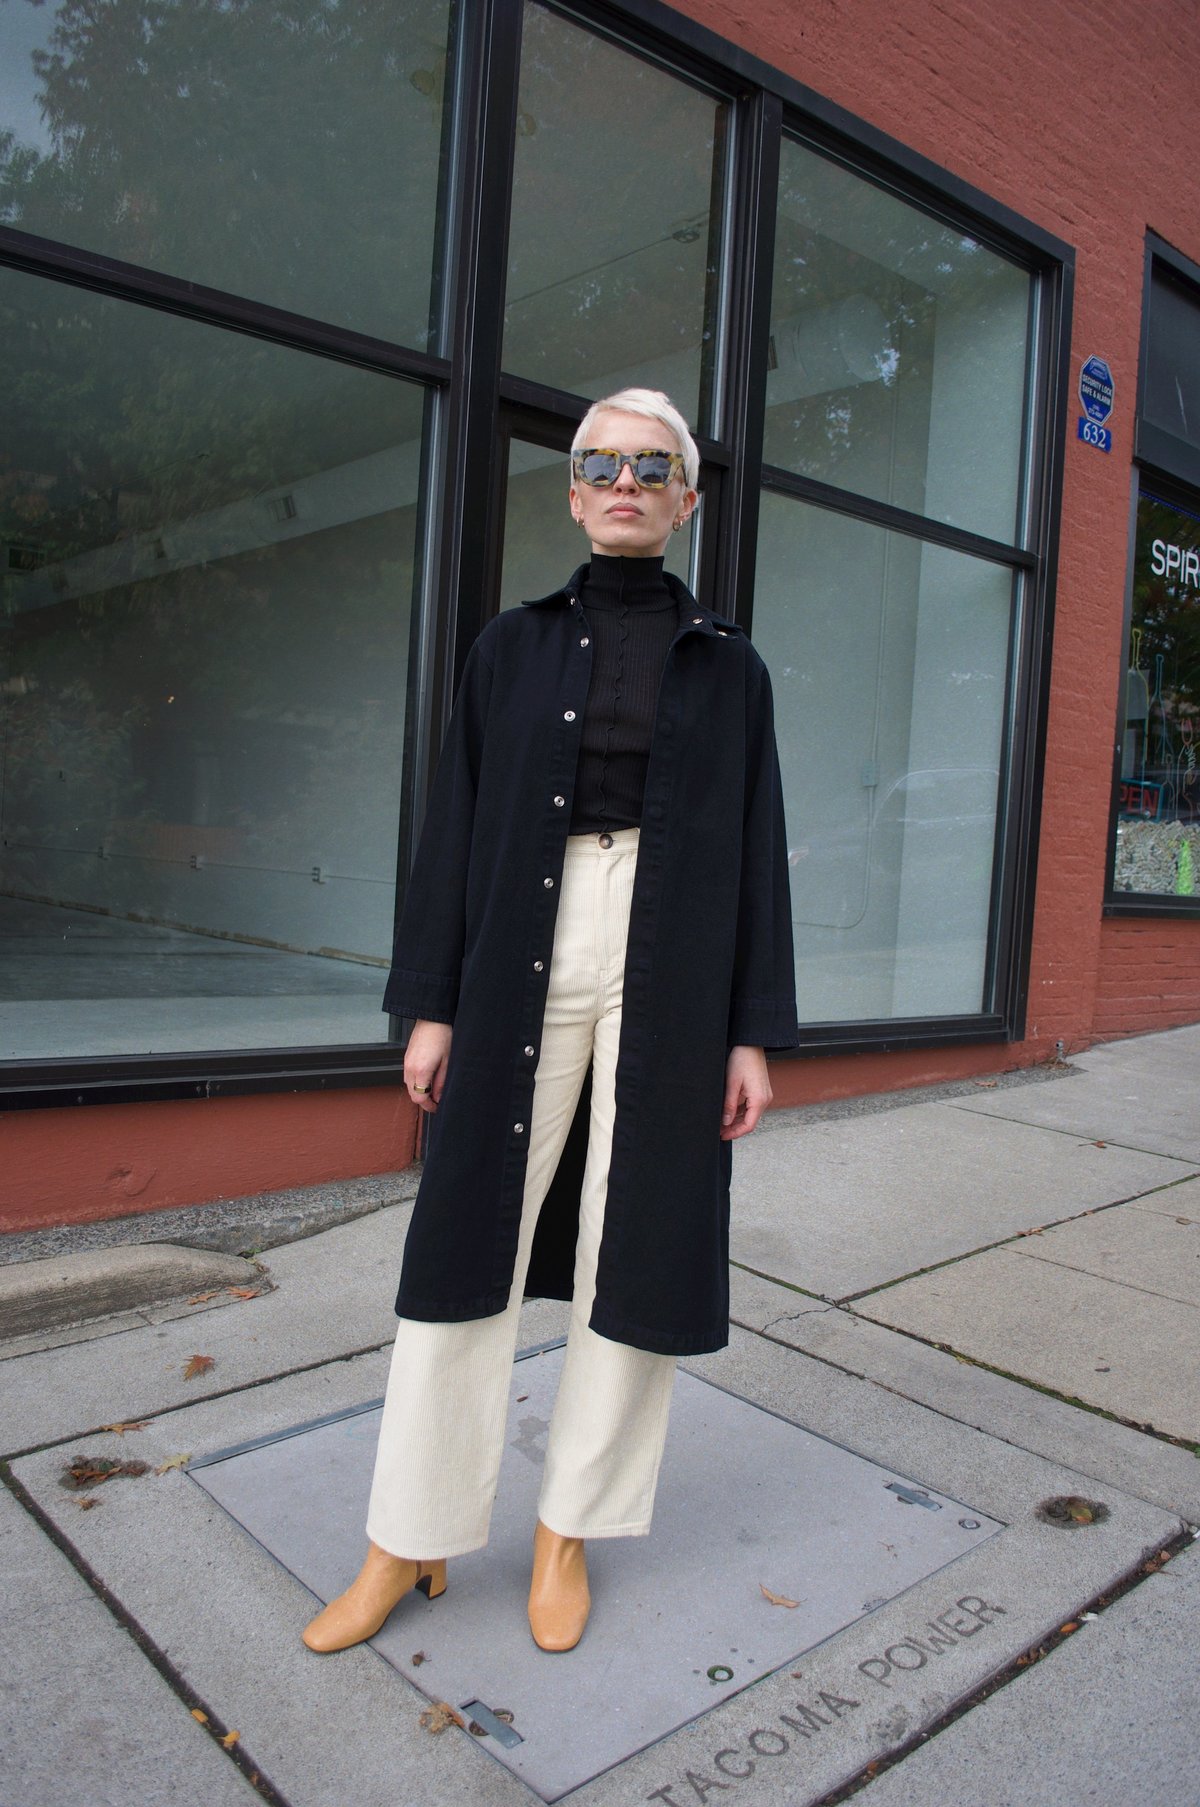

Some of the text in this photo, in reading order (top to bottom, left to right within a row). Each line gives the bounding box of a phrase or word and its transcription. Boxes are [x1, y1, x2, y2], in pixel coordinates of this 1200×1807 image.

[1082, 384, 1093, 396] SAFE
[1097, 393, 1111, 406] ALARM
[1083, 374, 1112, 396] SECURITY LOCK
[1083, 422, 1106, 448] 632
[1151, 539, 1199, 588] SPIR
[647, 1595, 1008, 1807] TACOMA POWER
